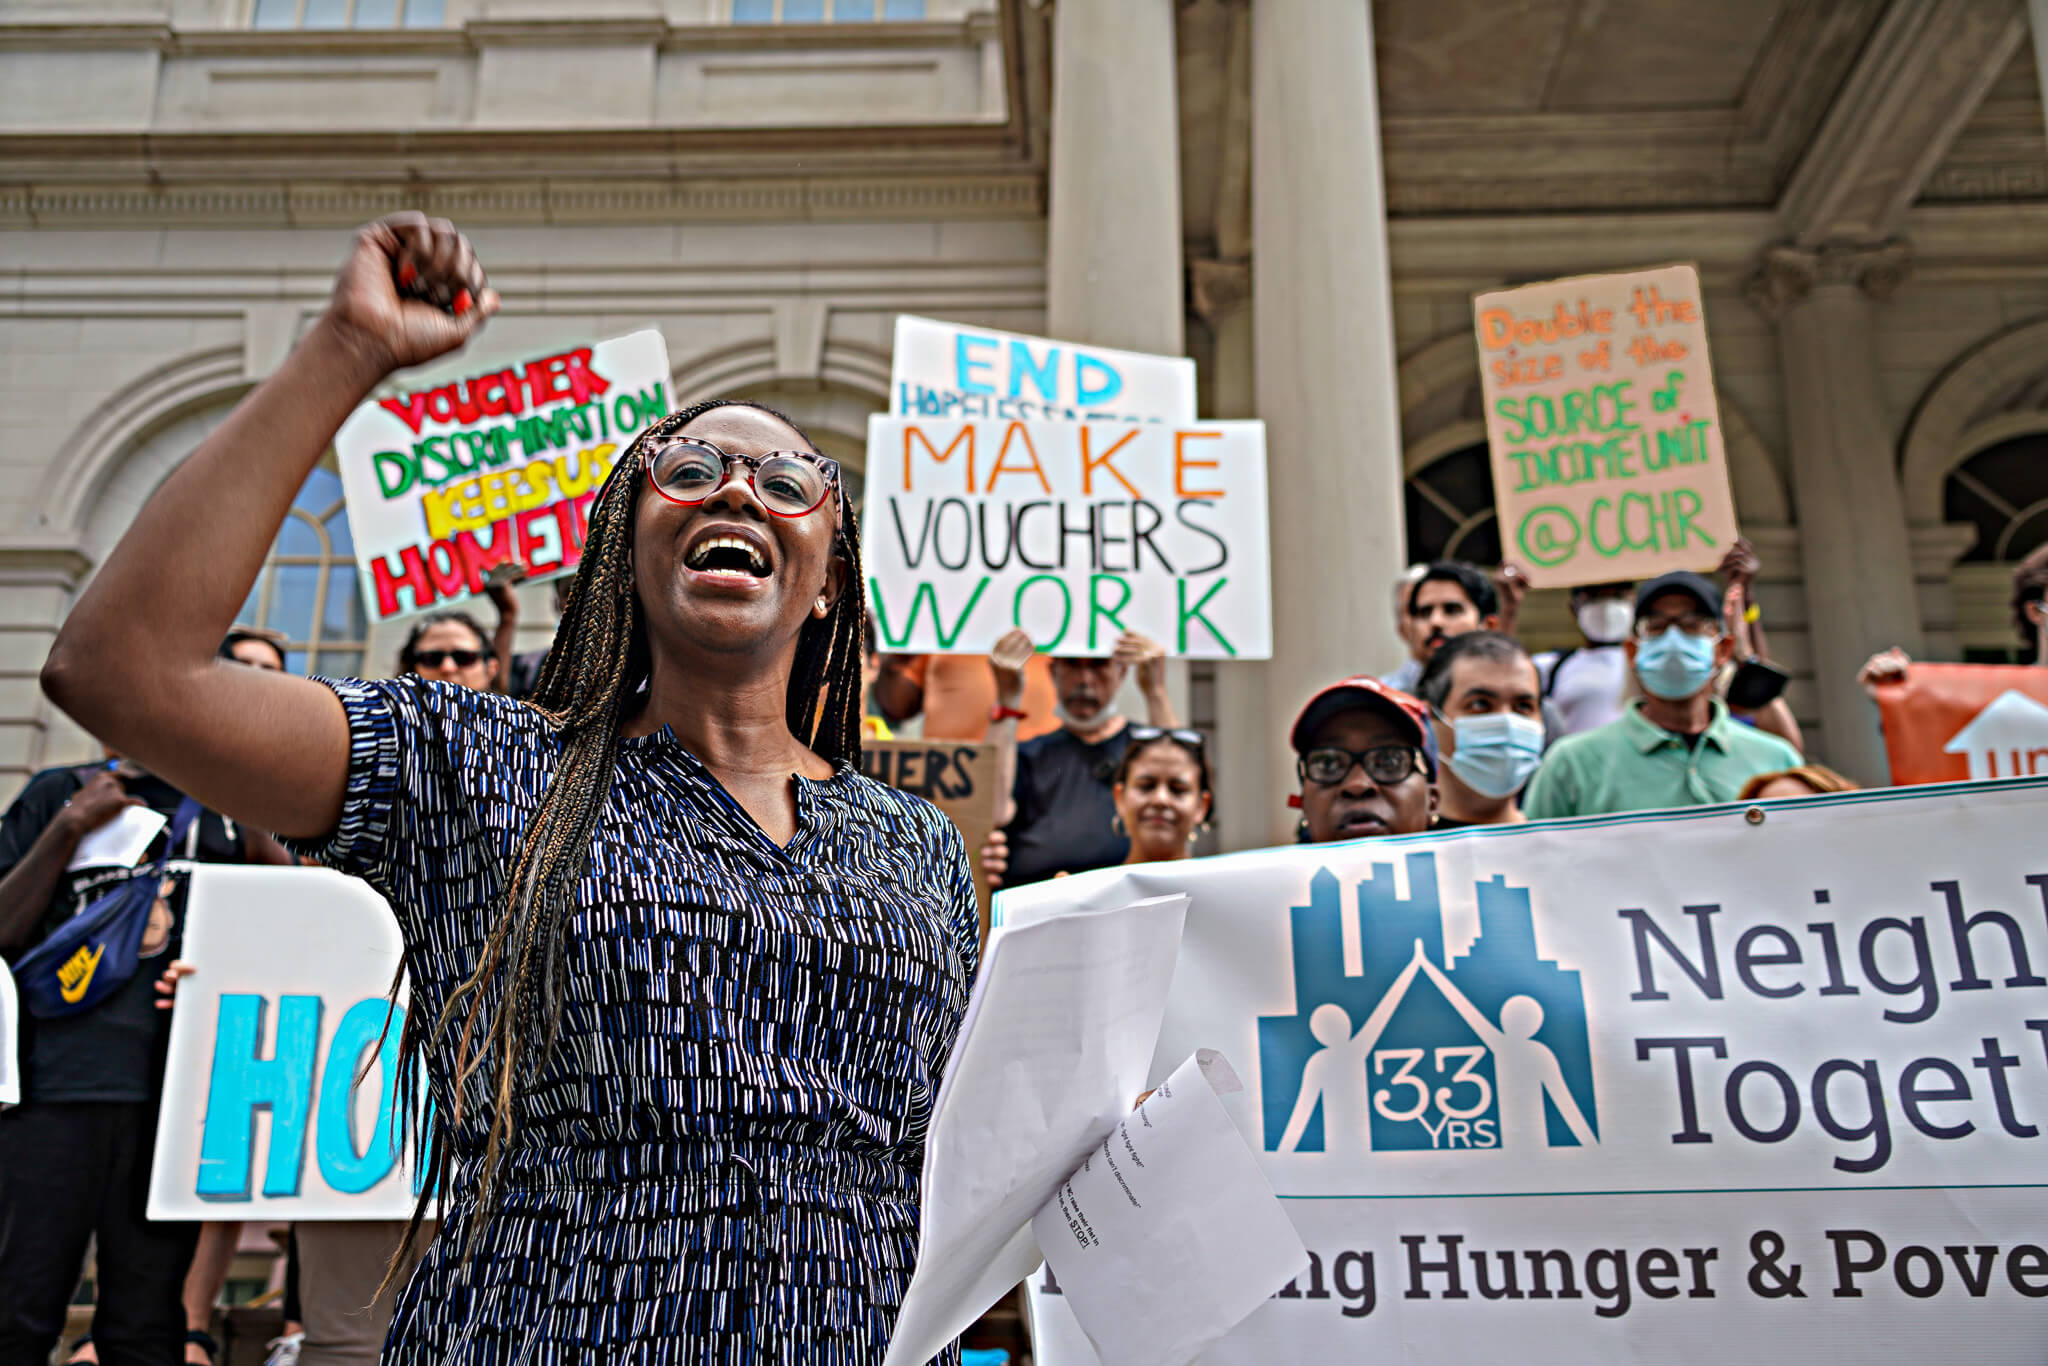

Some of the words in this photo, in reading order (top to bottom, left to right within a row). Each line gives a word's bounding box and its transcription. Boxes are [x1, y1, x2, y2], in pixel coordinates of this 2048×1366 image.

[1480, 299, 1613, 350] Double
[1631, 285, 1697, 327] the
[1579, 339, 1610, 371] of
[1628, 334, 1688, 367] the
[380, 347, 610, 434] VOUCHER
[956, 333, 1123, 407] END
[373, 381, 668, 499] DISCRIMINATION
[1495, 380, 1641, 445] SOURCE
[903, 421, 1225, 499] MAKE
[1507, 434, 1637, 493] INCOME
[422, 461, 552, 540] KEEPS
[888, 496, 1229, 575] VOUCHERS
[1516, 489, 1717, 568] @CCHR
[869, 574, 1237, 656] WORK
[56, 944, 94, 988] NIKE
[1374, 1046, 1492, 1121] 33
[1416, 1116, 1496, 1149] YRS
[1069, 1219, 1091, 1250] STOP!
[1266, 1248, 1376, 1318] ng
[1400, 1234, 1719, 1318] Hunger
[1747, 1231, 1808, 1299] &
